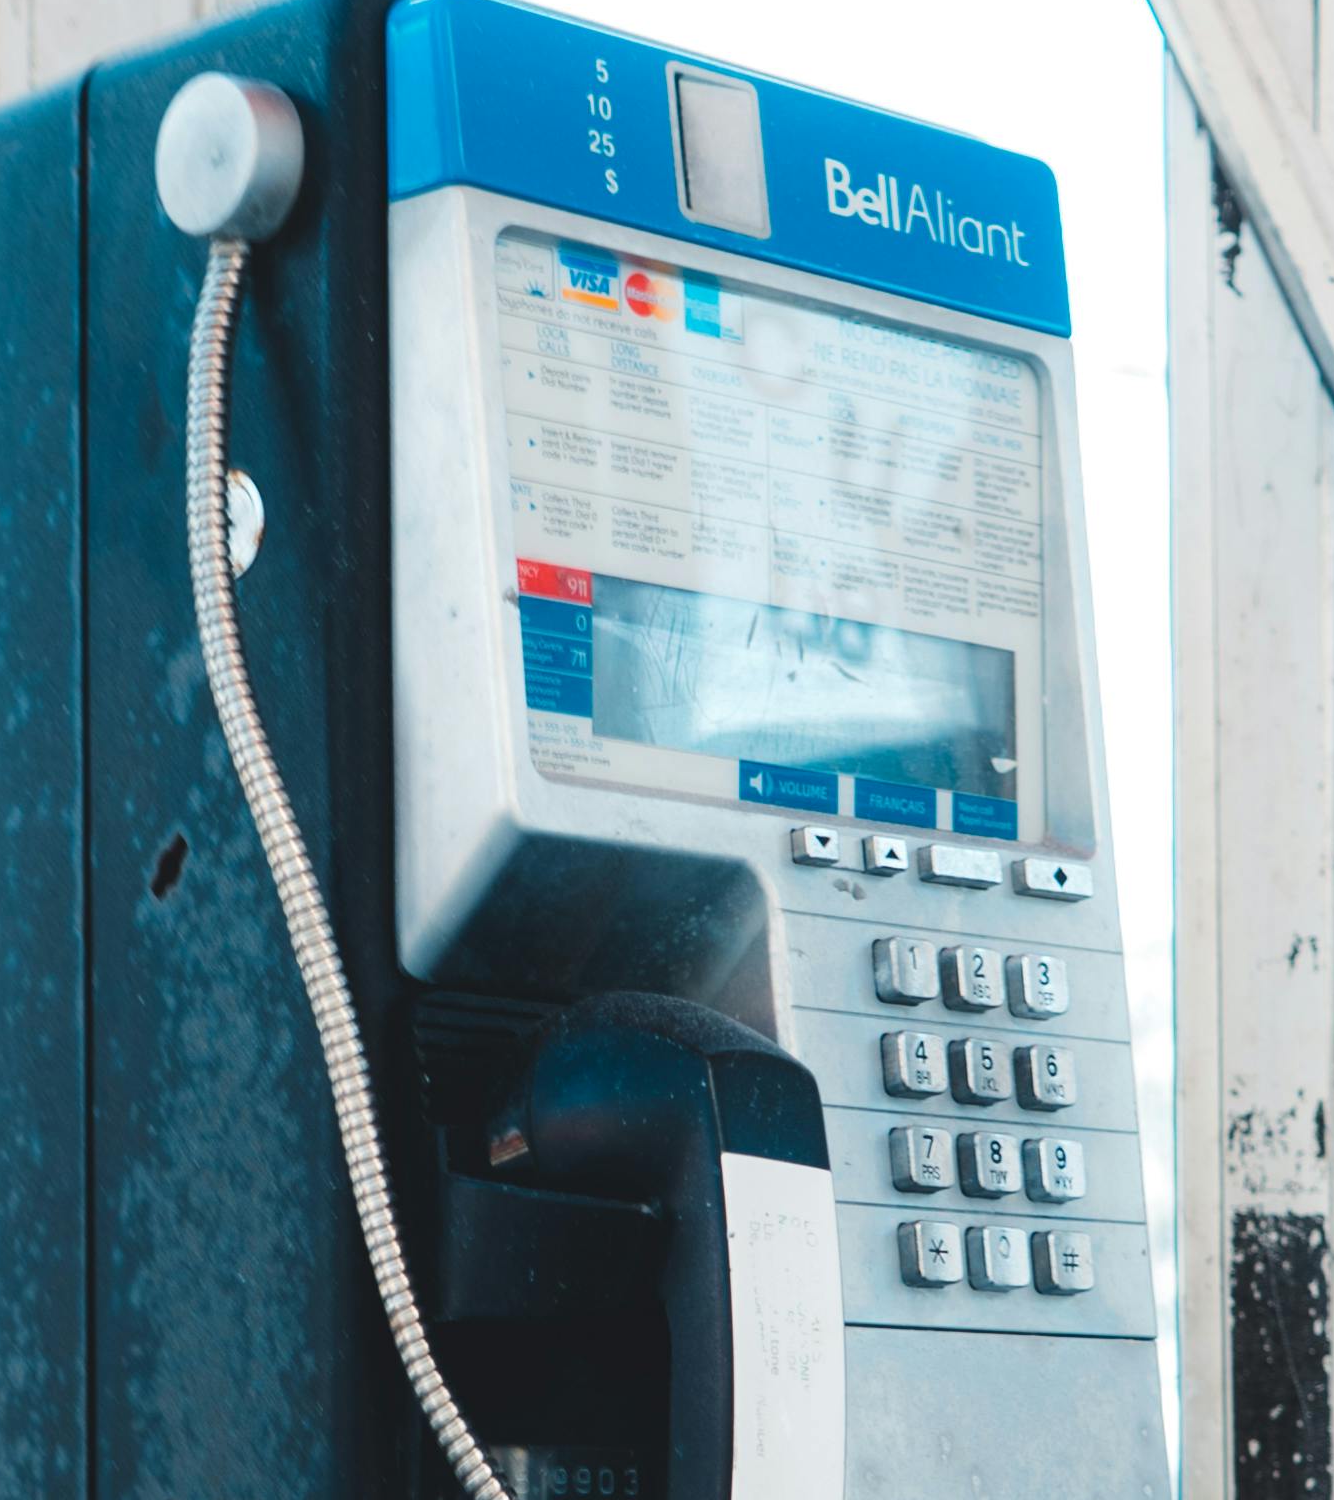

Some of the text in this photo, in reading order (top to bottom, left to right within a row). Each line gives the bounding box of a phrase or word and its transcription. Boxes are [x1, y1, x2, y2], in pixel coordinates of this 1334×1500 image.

[595, 59, 610, 84] 5
[587, 93, 612, 121] 10
[588, 129, 615, 158] 25
[605, 168, 619, 196] $
[569, 269, 611, 297] VISA
[611, 356, 659, 378] DISTANCE
[567, 576, 589, 598] 911
[575, 613, 588, 633] 0
[570, 647, 588, 669] 711
[779, 780, 828, 799] VOLUME
[869, 793, 926, 816] FRANÇAIS
[908, 945, 919, 970] 1
[972, 954, 986, 979] 2
[1037, 962, 1050, 986] 3
[914, 1040, 928, 1064] 4
[981, 1047, 994, 1071] 5
[1046, 1054, 1058, 1077] 6
[922, 1135, 934, 1159] 7
[990, 1140, 1002, 1165] 8
[1055, 1146, 1067, 1170] 9
